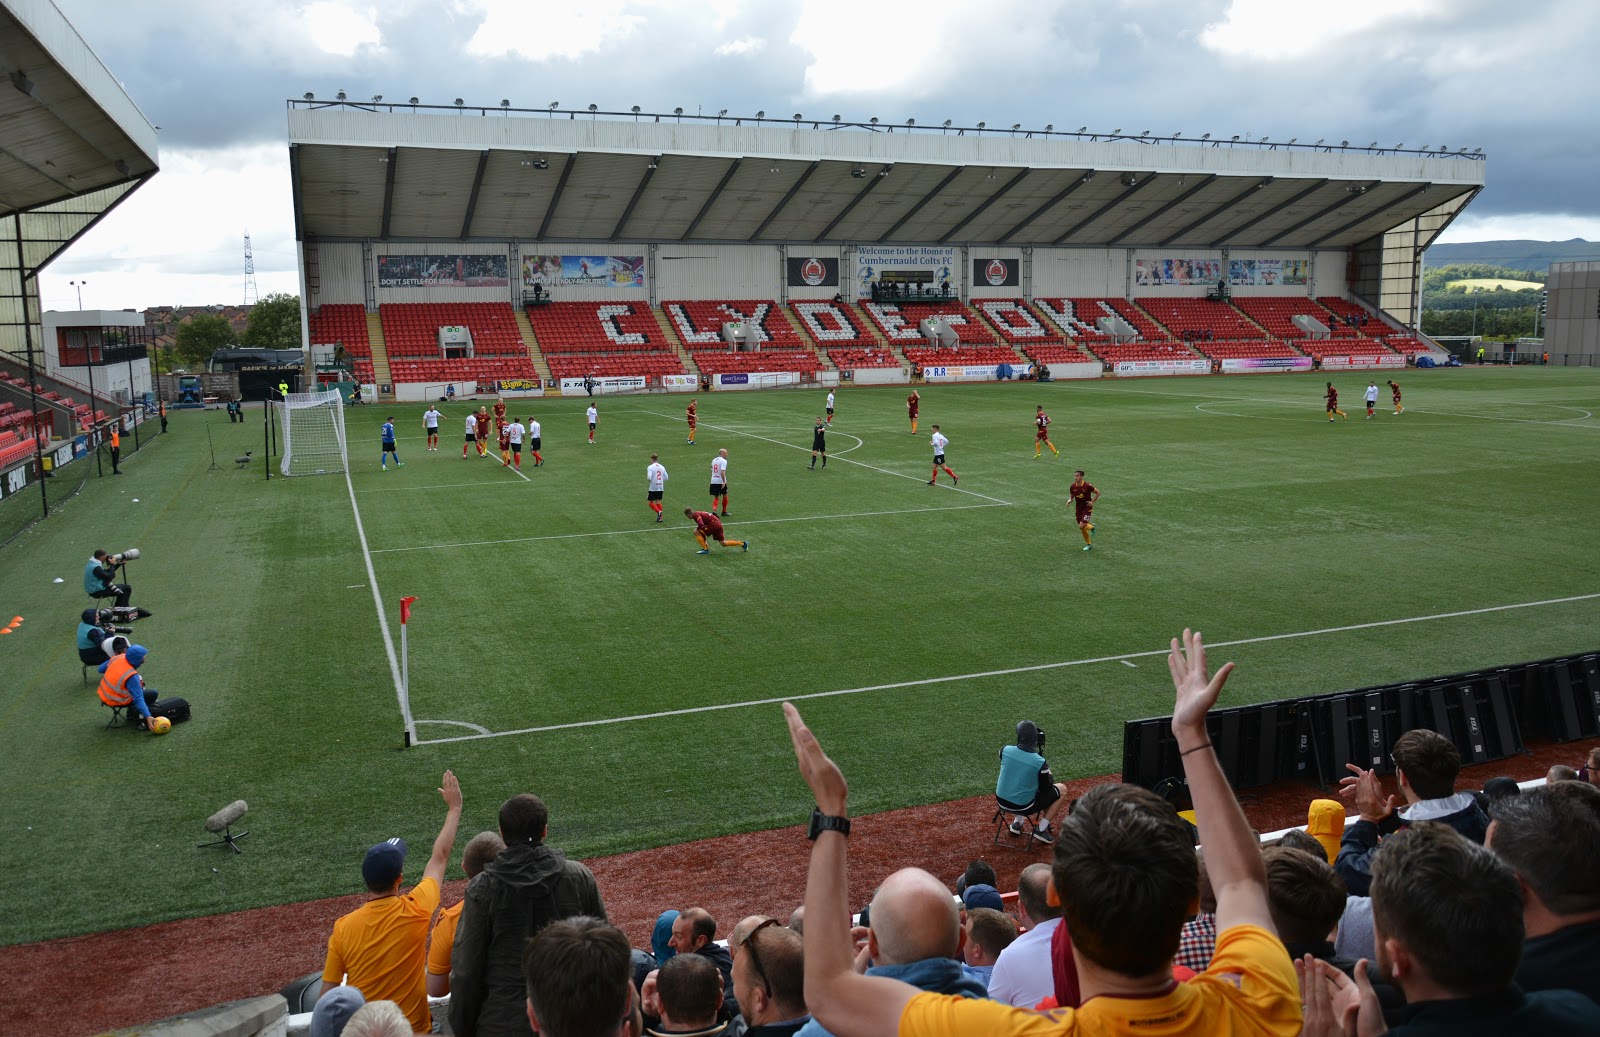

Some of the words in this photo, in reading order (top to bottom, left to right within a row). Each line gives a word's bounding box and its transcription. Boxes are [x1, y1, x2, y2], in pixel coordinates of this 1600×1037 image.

[714, 464, 718, 473] 8
[657, 471, 661, 480] 2
[1470, 717, 1478, 732] TGI
